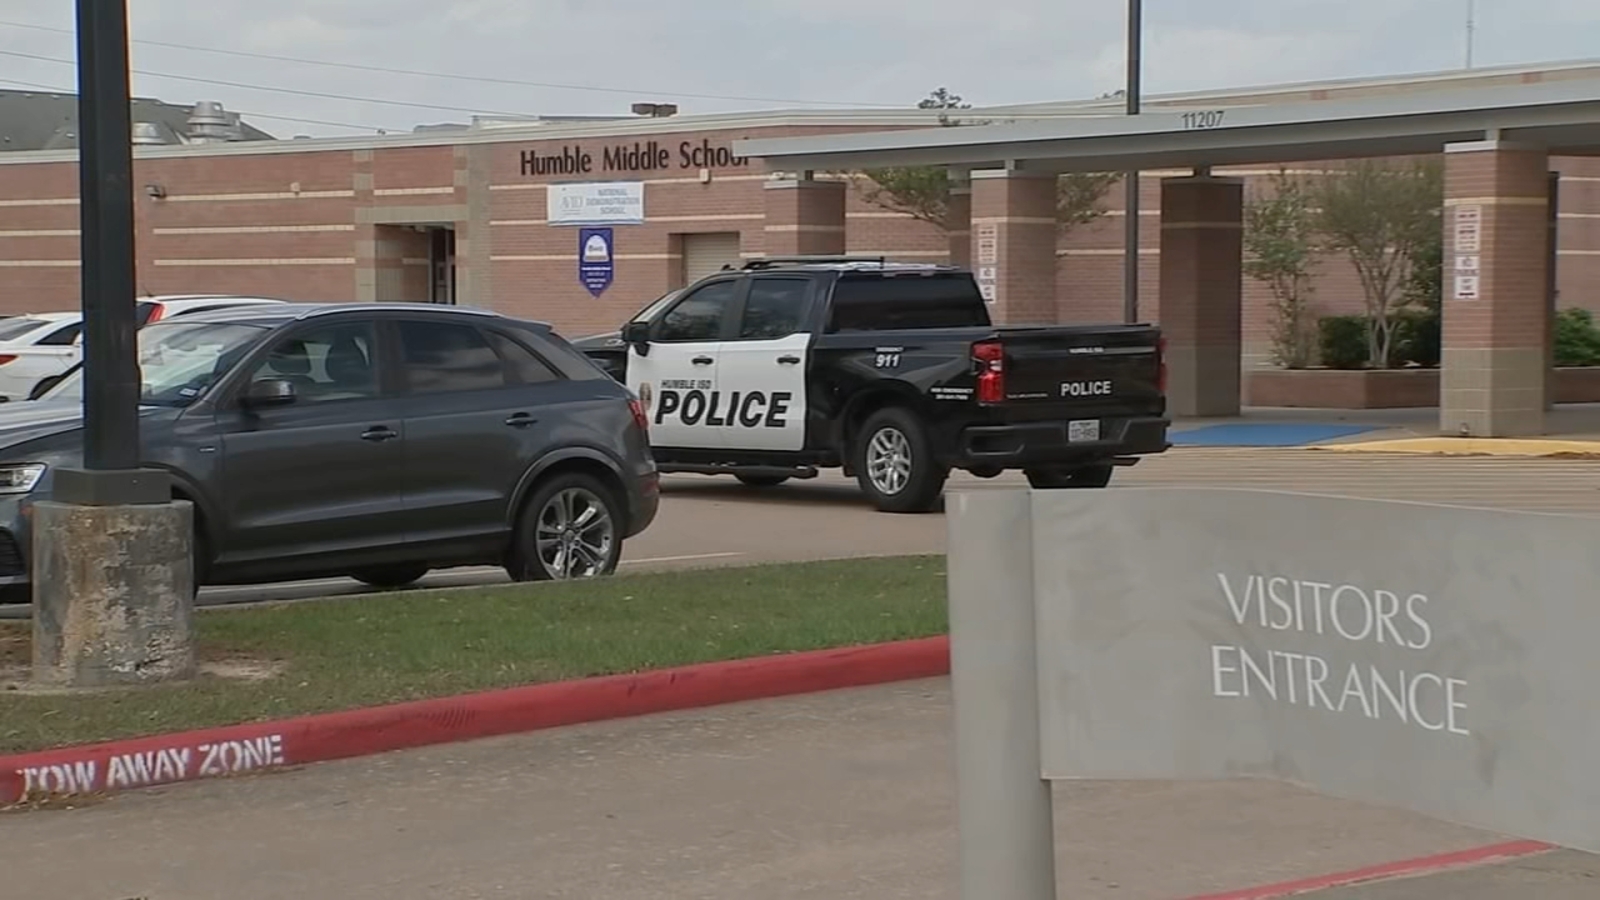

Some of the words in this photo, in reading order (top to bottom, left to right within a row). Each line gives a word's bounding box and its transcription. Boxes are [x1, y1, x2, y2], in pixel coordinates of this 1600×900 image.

[1181, 110, 1224, 129] 11207
[520, 146, 592, 175] Humble
[603, 141, 669, 171] Middle
[875, 353, 901, 368] 911
[660, 379, 695, 389] HUMBLE
[1060, 380, 1112, 397] POLICE
[654, 389, 792, 428] POLICE
[1217, 573, 1432, 649] VISITORS
[1211, 645, 1470, 736] ENTRANCE
[15, 760, 96, 801] TOW
[106, 747, 190, 788] AWAY
[198, 734, 284, 777] ZONE
